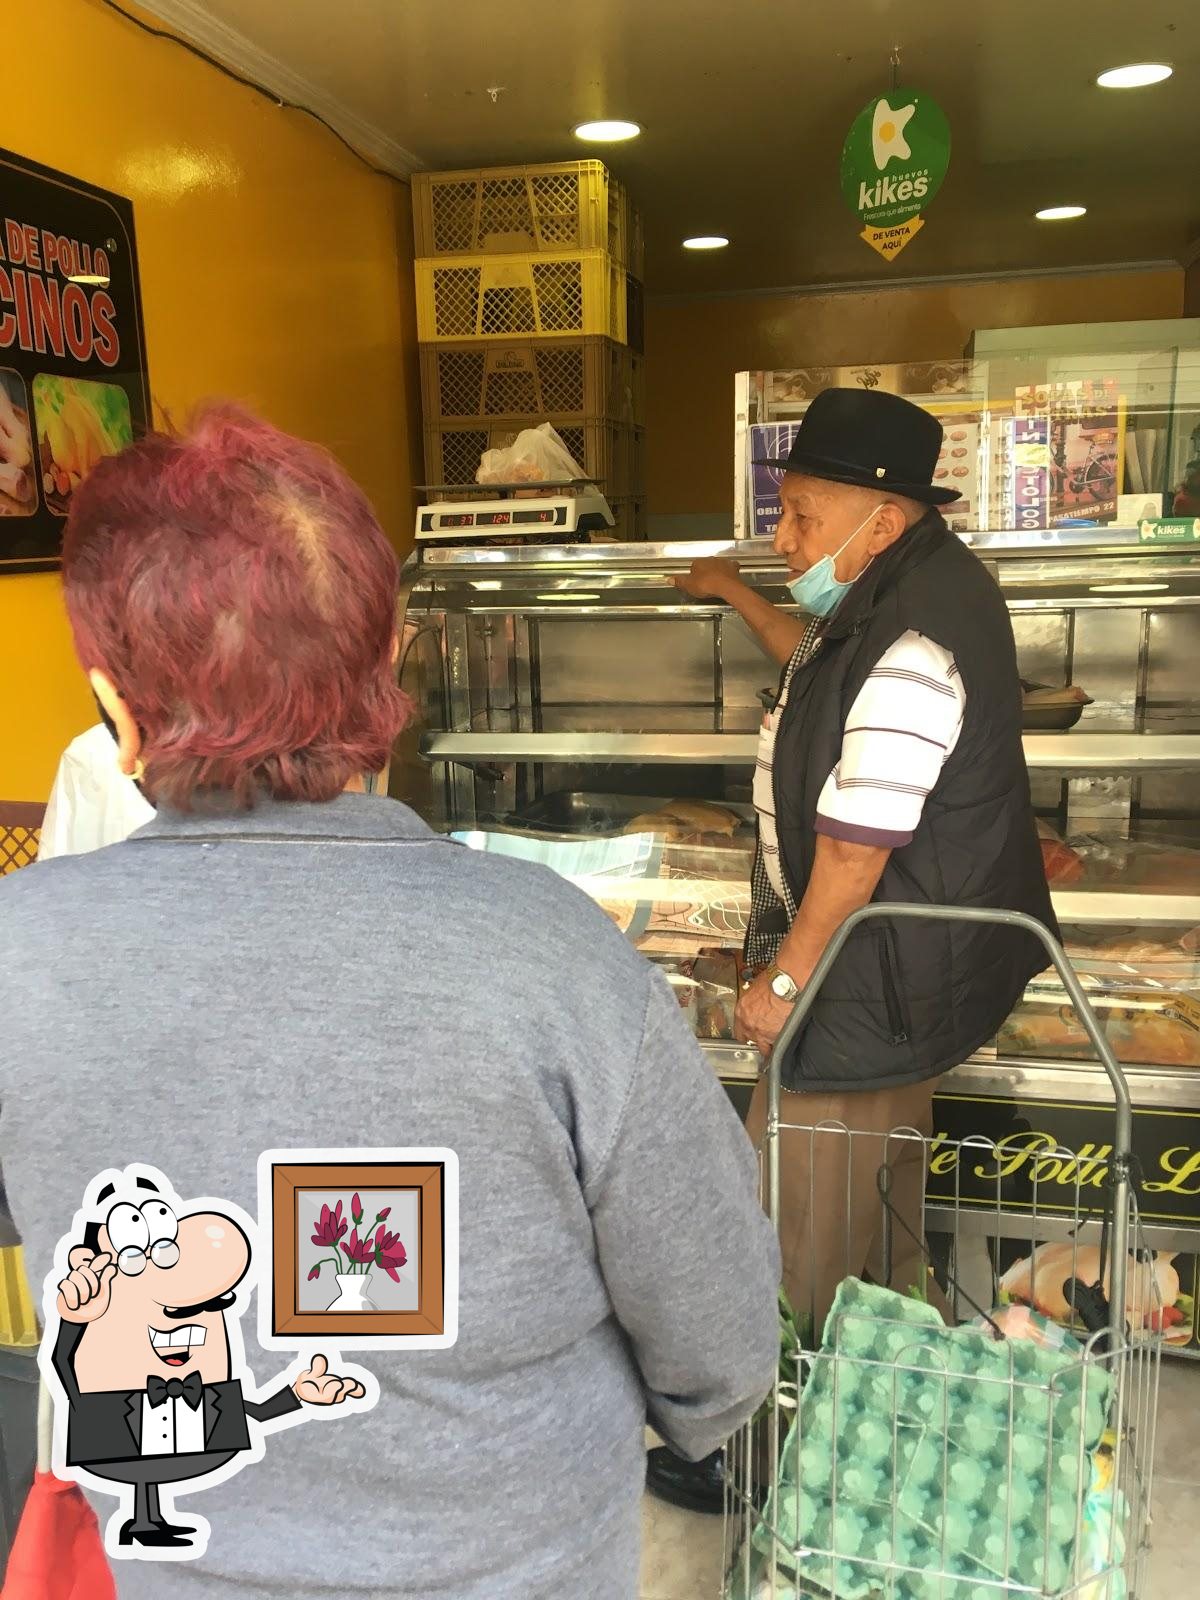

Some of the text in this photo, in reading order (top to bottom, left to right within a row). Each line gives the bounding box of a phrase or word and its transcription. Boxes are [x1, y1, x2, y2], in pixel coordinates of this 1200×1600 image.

[892, 169, 928, 182] huevos
[858, 177, 929, 210] kikes
[872, 227, 911, 241] DE VENTA
[5, 218, 42, 271] DE
[41, 229, 110, 289] POLLO
[1103, 501, 1115, 511] 22
[1157, 525, 1186, 535] kikes
